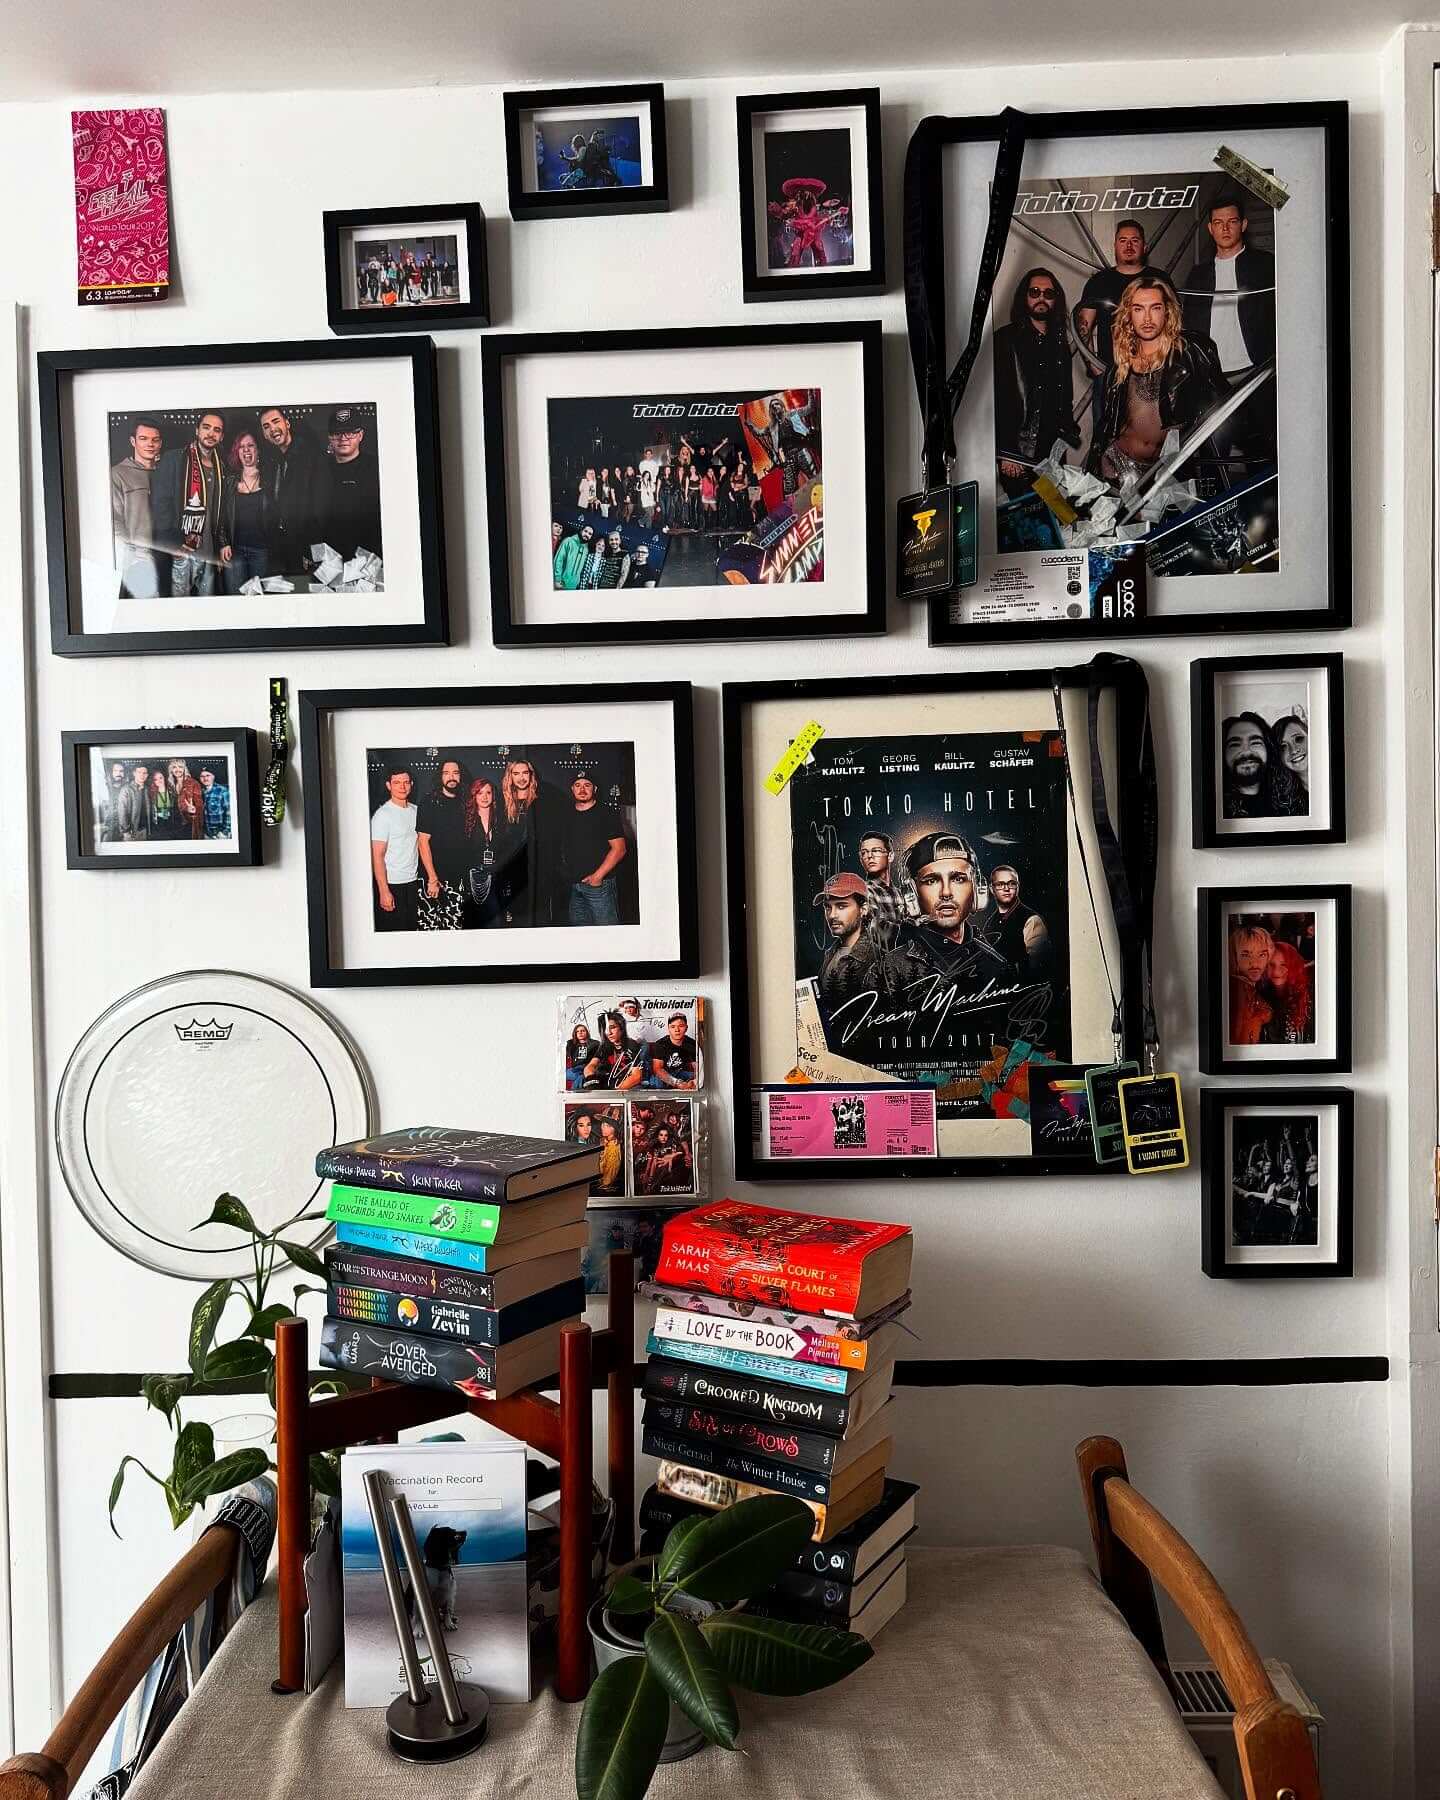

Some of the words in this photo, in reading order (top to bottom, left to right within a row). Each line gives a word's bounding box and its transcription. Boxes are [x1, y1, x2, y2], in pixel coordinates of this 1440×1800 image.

[1012, 190, 1098, 215] Tokio
[1098, 186, 1200, 212] Hotel
[92, 223, 118, 231] WORLD
[86, 290, 104, 300] 6.3.
[633, 404, 685, 418] Tokio
[833, 757, 854, 766] TOM
[882, 754, 917, 763] GEORG
[944, 752, 965, 761] BILL
[993, 748, 1031, 758] GUSTAV
[822, 766, 865, 776] KAULITZ
[879, 764, 920, 773] LISTING
[934, 761, 976, 771] KAULITZ
[989, 758, 1034, 768] SCHÄFER
[823, 793, 912, 818] TOKIO
[944, 788, 1036, 812] HOTEL
[642, 999, 668, 1010] Tokio
[667, 999, 695, 1010] Hotel
[829, 990, 917, 1044] Dream
[902, 973, 1050, 1048] Machine
[183, 1030, 226, 1038] REMO
[878, 1035, 927, 1049] TOUR
[948, 1033, 994, 1047] 2017
[797, 1046, 818, 1062] See
[411, 1174, 432, 1188] SKIN
[432, 1177, 463, 1191] TAKER
[354, 1195, 369, 1205] THE
[370, 1197, 398, 1209] BALLAD
[400, 1201, 410, 1210] OF
[335, 1203, 376, 1217] SONGBIRDS
[376, 1208, 395, 1220] AND
[395, 1211, 424, 1225] SNAKES
[671, 1243, 711, 1259] SARAH
[331, 1261, 352, 1273] STAR
[360, 1266, 400, 1281] STRANGE
[400, 1273, 428, 1286] MOON
[677, 1259, 710, 1274] MAAS
[775, 1263, 784, 1274] A
[787, 1265, 826, 1280] COURT
[750, 1273, 788, 1288] SILVER
[790, 1281, 836, 1298] FLAMES
[337, 1286, 388, 1303] TOMORROW
[337, 1297, 389, 1313] TOMORROW
[431, 1305, 470, 1321] Gabrielle
[431, 1315, 470, 1337] Zevin
[686, 1318, 724, 1341] LOVE
[725, 1328, 737, 1339] BY
[737, 1331, 753, 1342] THE
[755, 1329, 795, 1352] BOOK
[811, 1336, 840, 1350] Melissa
[350, 1331, 360, 1364] WARD
[390, 1343, 428, 1361] LOVER
[807, 1349, 841, 1361] Pimentel
[381, 1355, 437, 1377] AVENGED
[694, 1379, 760, 1404] CROOKED
[762, 1391, 823, 1421] KINGDOM
[383, 1474, 443, 1486] Vaccination
[446, 1475, 483, 1484] Record
[740, 1459, 773, 1481] Winter
[776, 1470, 807, 1490] House
